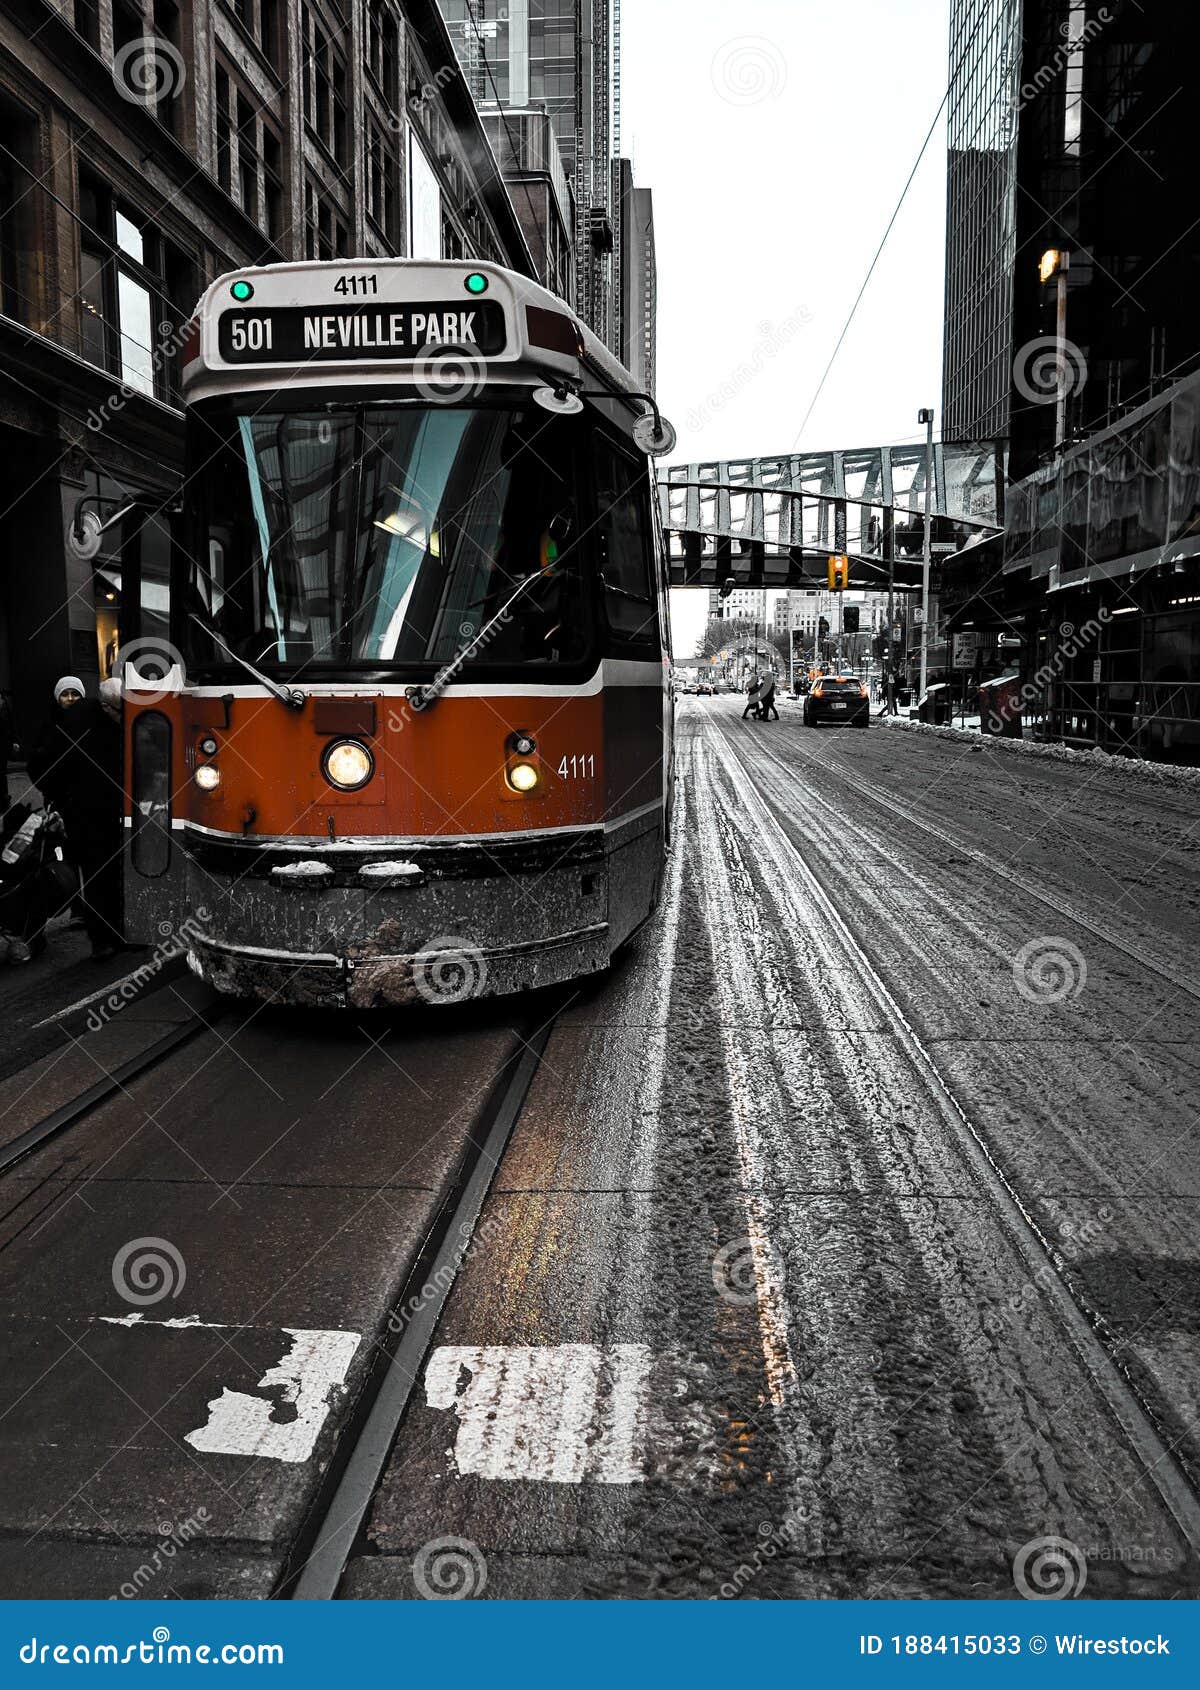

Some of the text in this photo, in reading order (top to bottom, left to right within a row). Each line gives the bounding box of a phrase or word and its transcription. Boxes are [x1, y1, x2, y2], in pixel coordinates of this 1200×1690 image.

[334, 274, 378, 296] 4111
[231, 311, 477, 351] 501 NEVILLE PARK
[557, 753, 595, 780] 4111
